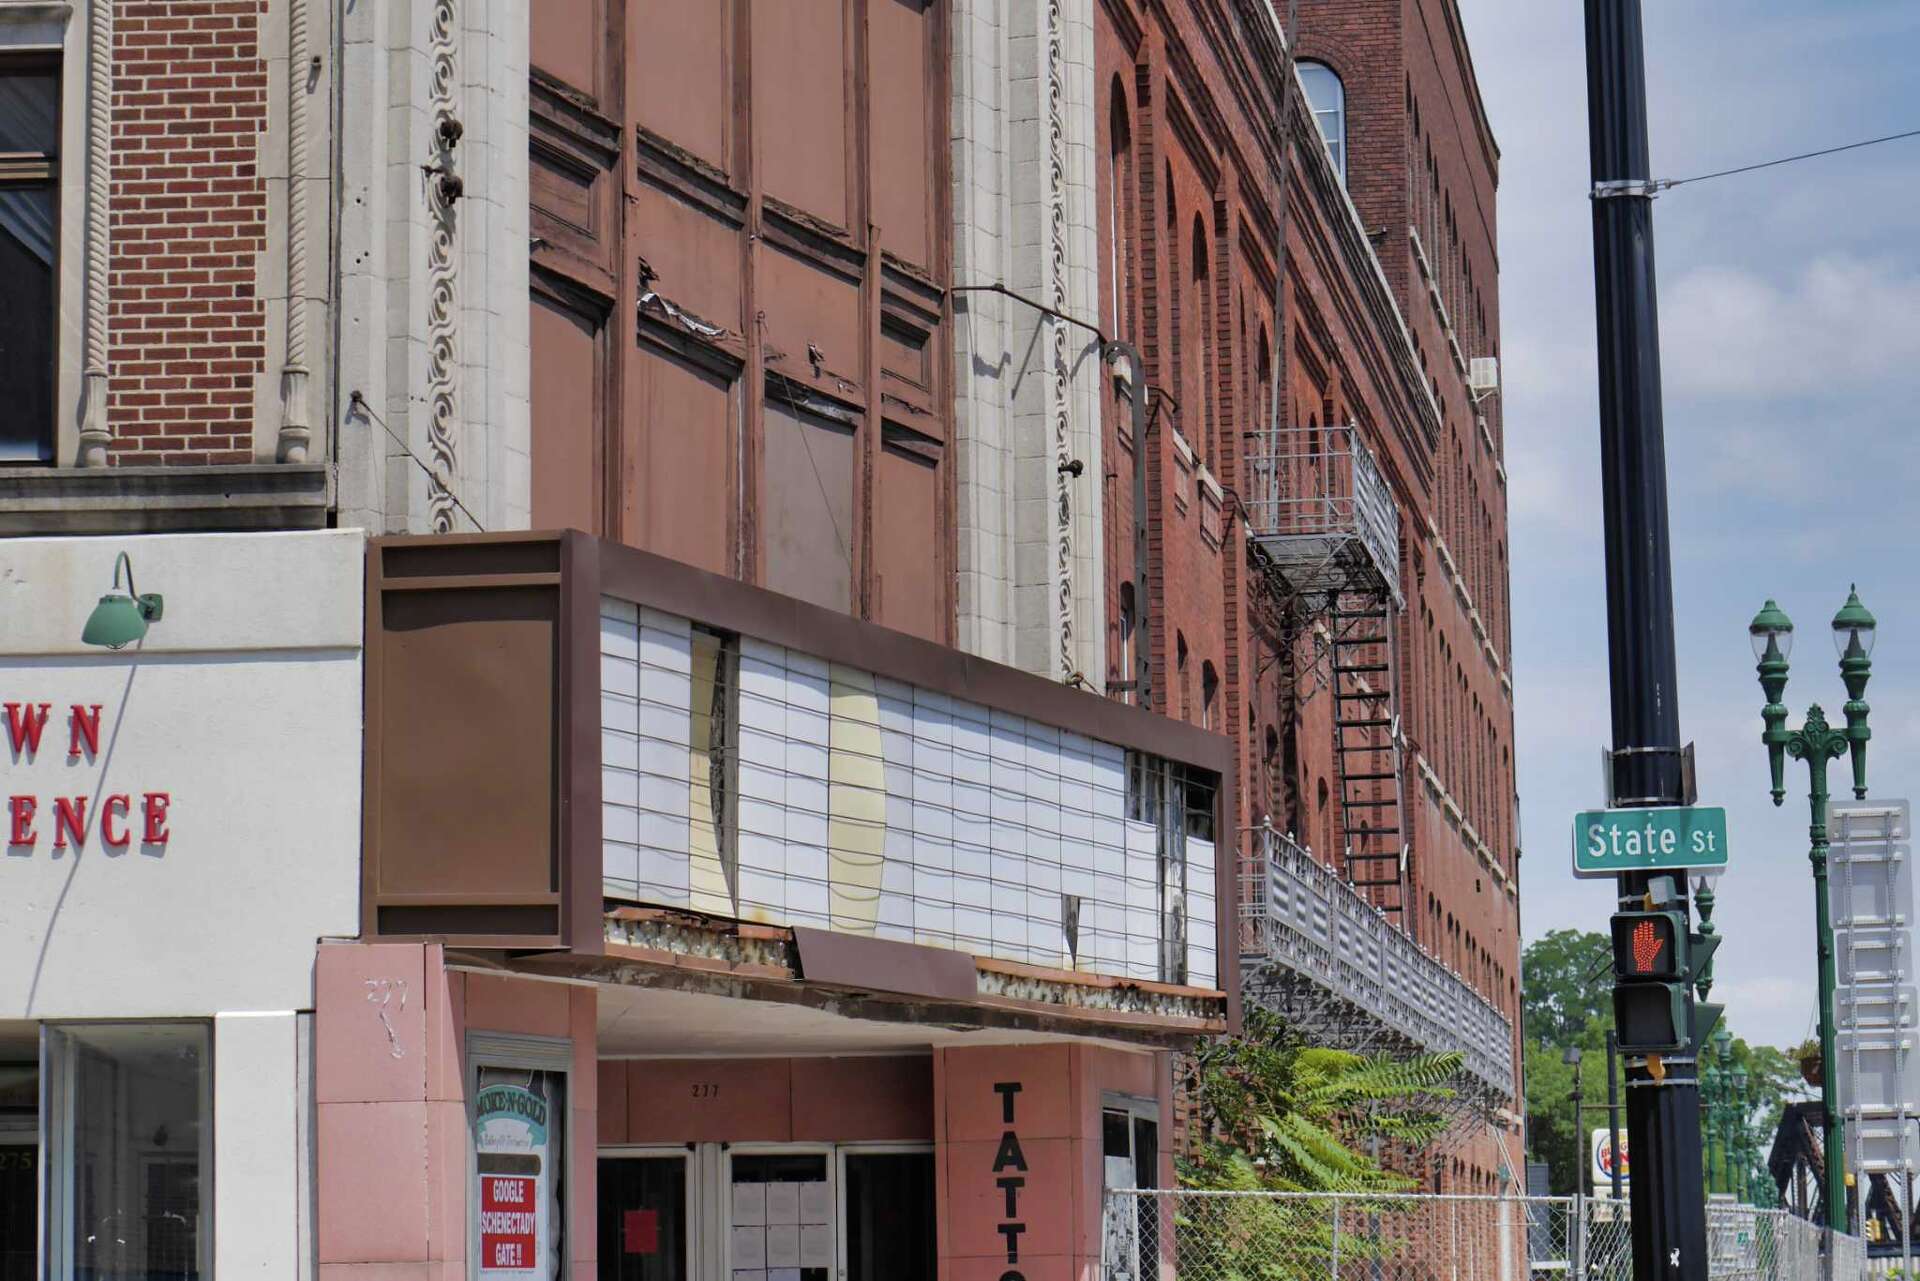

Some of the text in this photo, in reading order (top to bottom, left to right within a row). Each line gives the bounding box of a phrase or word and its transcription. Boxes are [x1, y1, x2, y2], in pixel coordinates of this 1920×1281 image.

[3, 703, 103, 755] WN
[9, 793, 170, 848] ENCE
[1588, 823, 1716, 857] State St
[691, 1084, 719, 1097] 277
[494, 1180, 524, 1203] GOOGLE
[992, 1082, 1028, 1281] TATT
[481, 1211, 536, 1235] SCHENECTADY
